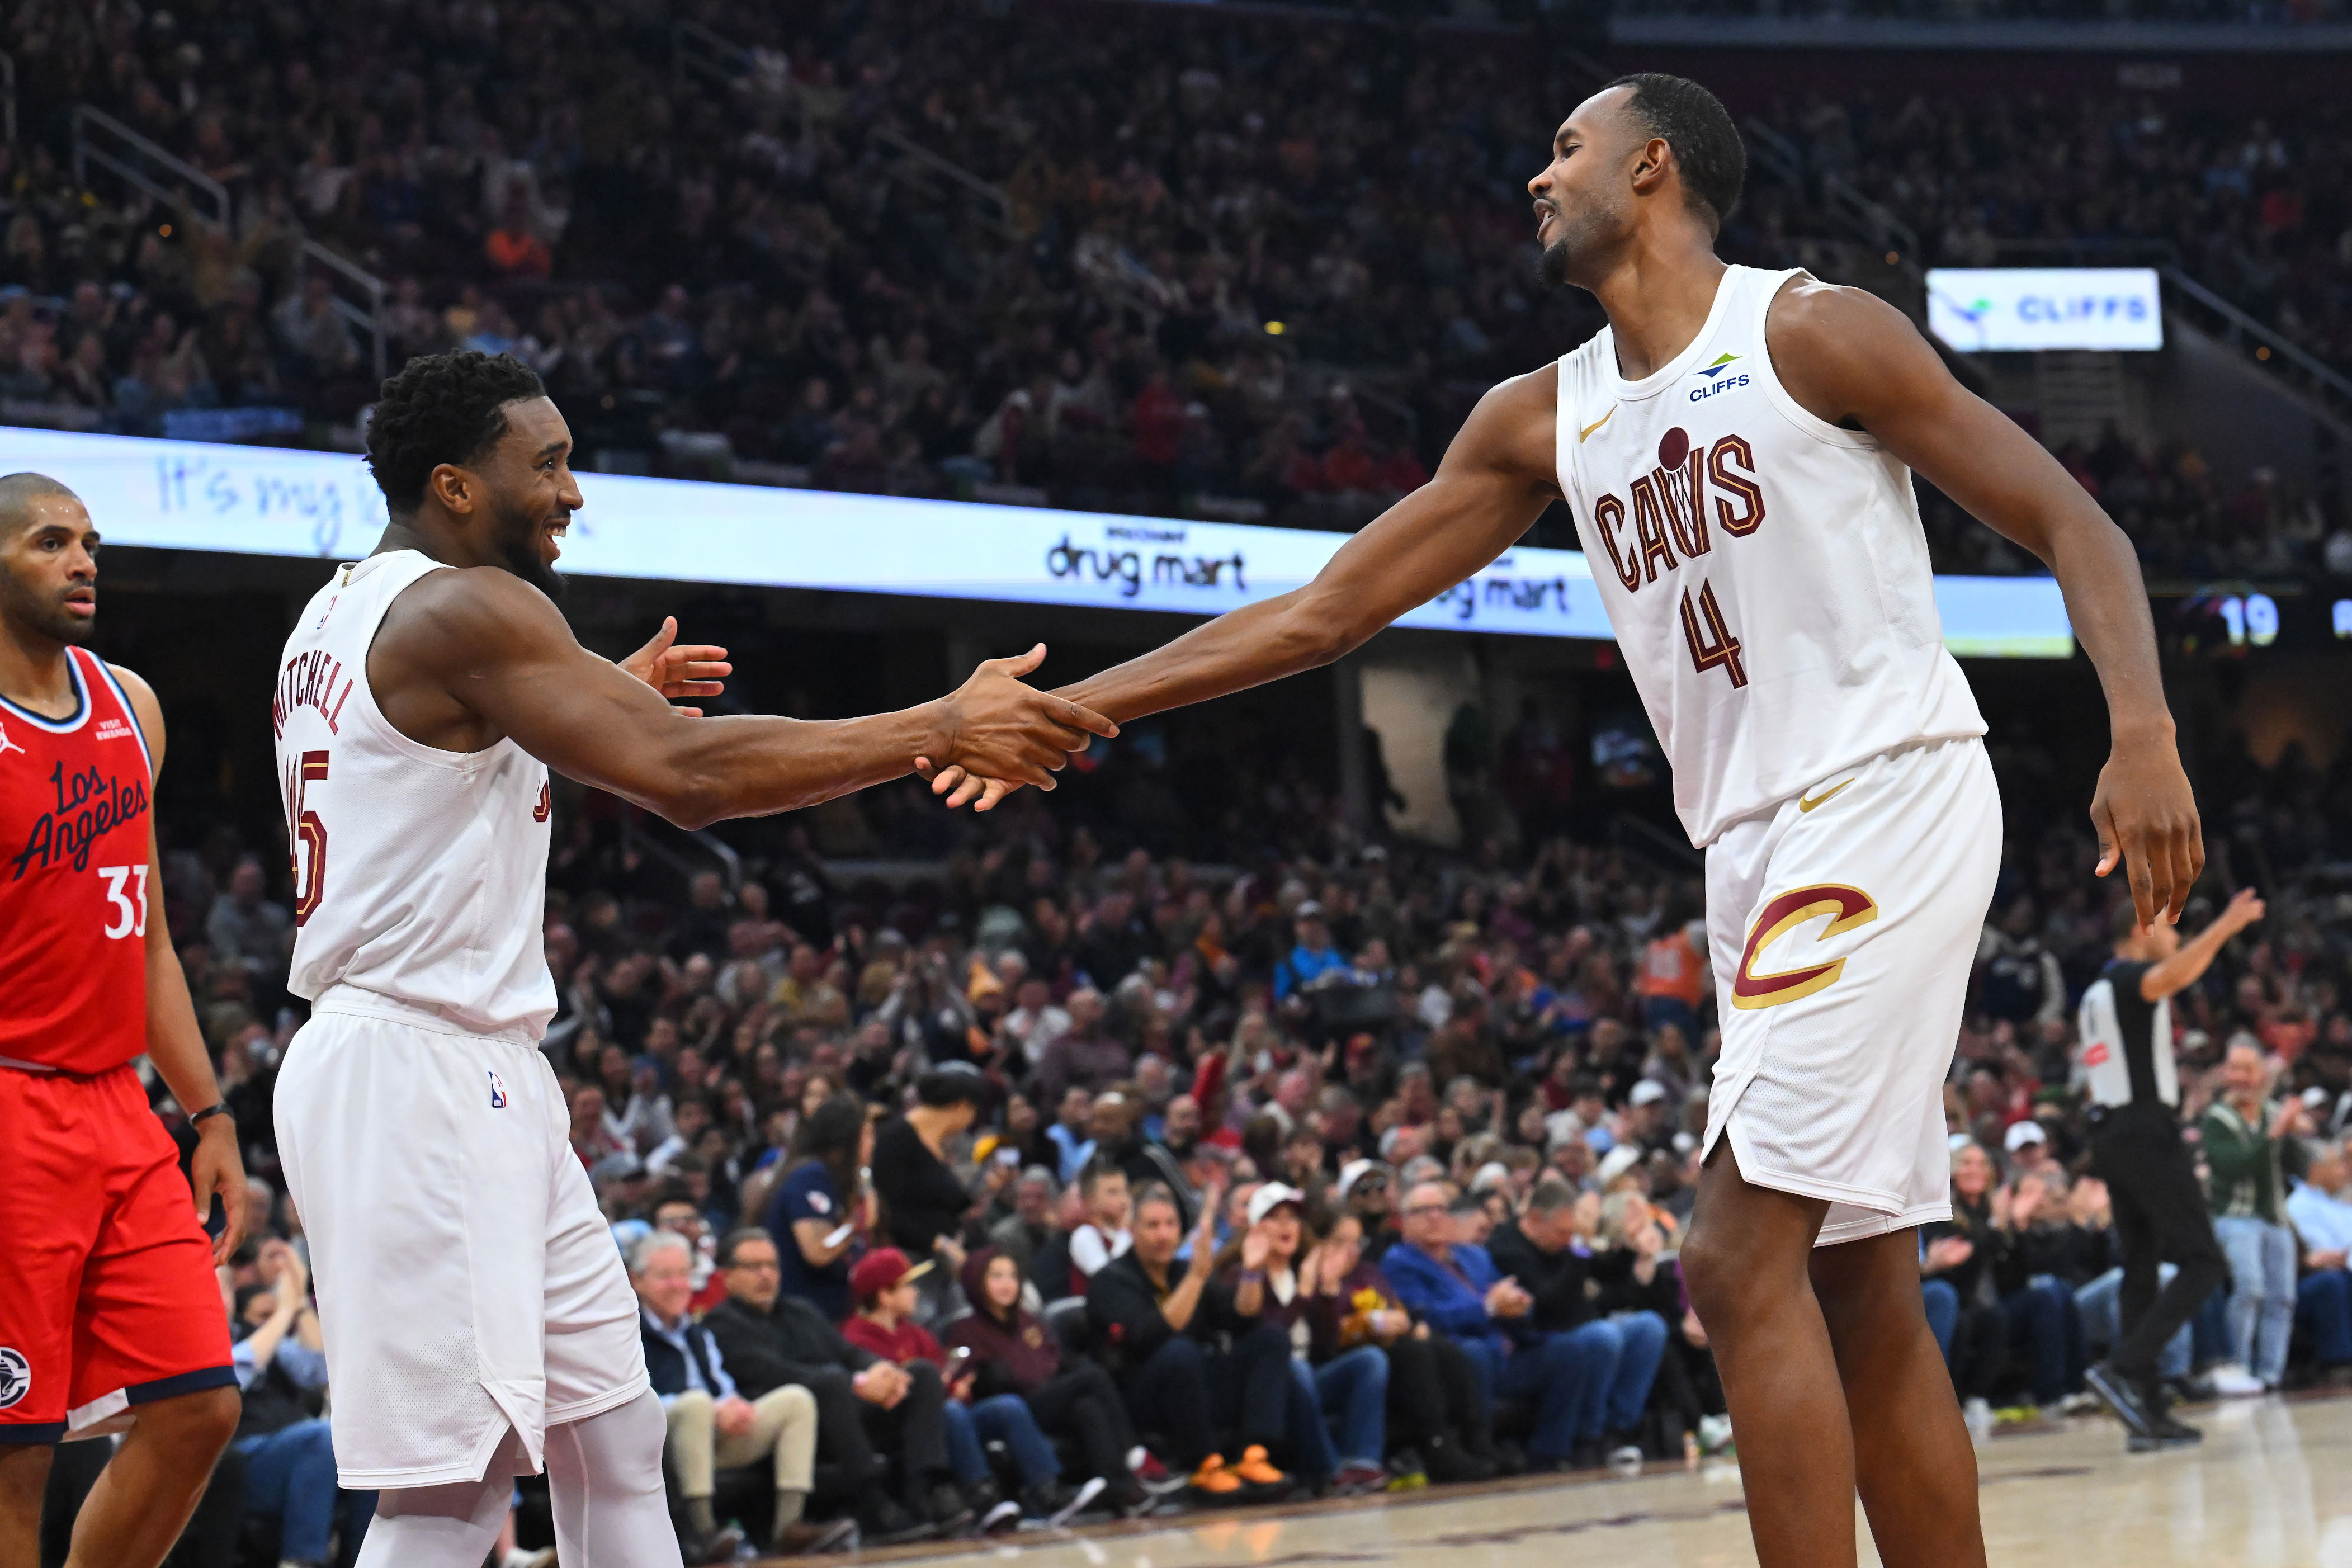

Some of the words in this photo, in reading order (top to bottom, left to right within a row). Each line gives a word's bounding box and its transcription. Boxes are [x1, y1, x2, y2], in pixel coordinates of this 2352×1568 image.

[2016, 295, 2148, 324] CLIFFS
[1690, 374, 1750, 402] CLIFFS
[1594, 433, 1765, 593] CAVS
[1048, 536, 1140, 597] drug
[1155, 555, 1245, 590] mart
[1485, 577, 1568, 615] mart
[2220, 593, 2279, 646] 19
[1680, 578, 1748, 689] 4
[272, 650, 353, 741] MITCHELL
[50, 760, 107, 816] Los
[12, 780, 147, 881] Angeles
